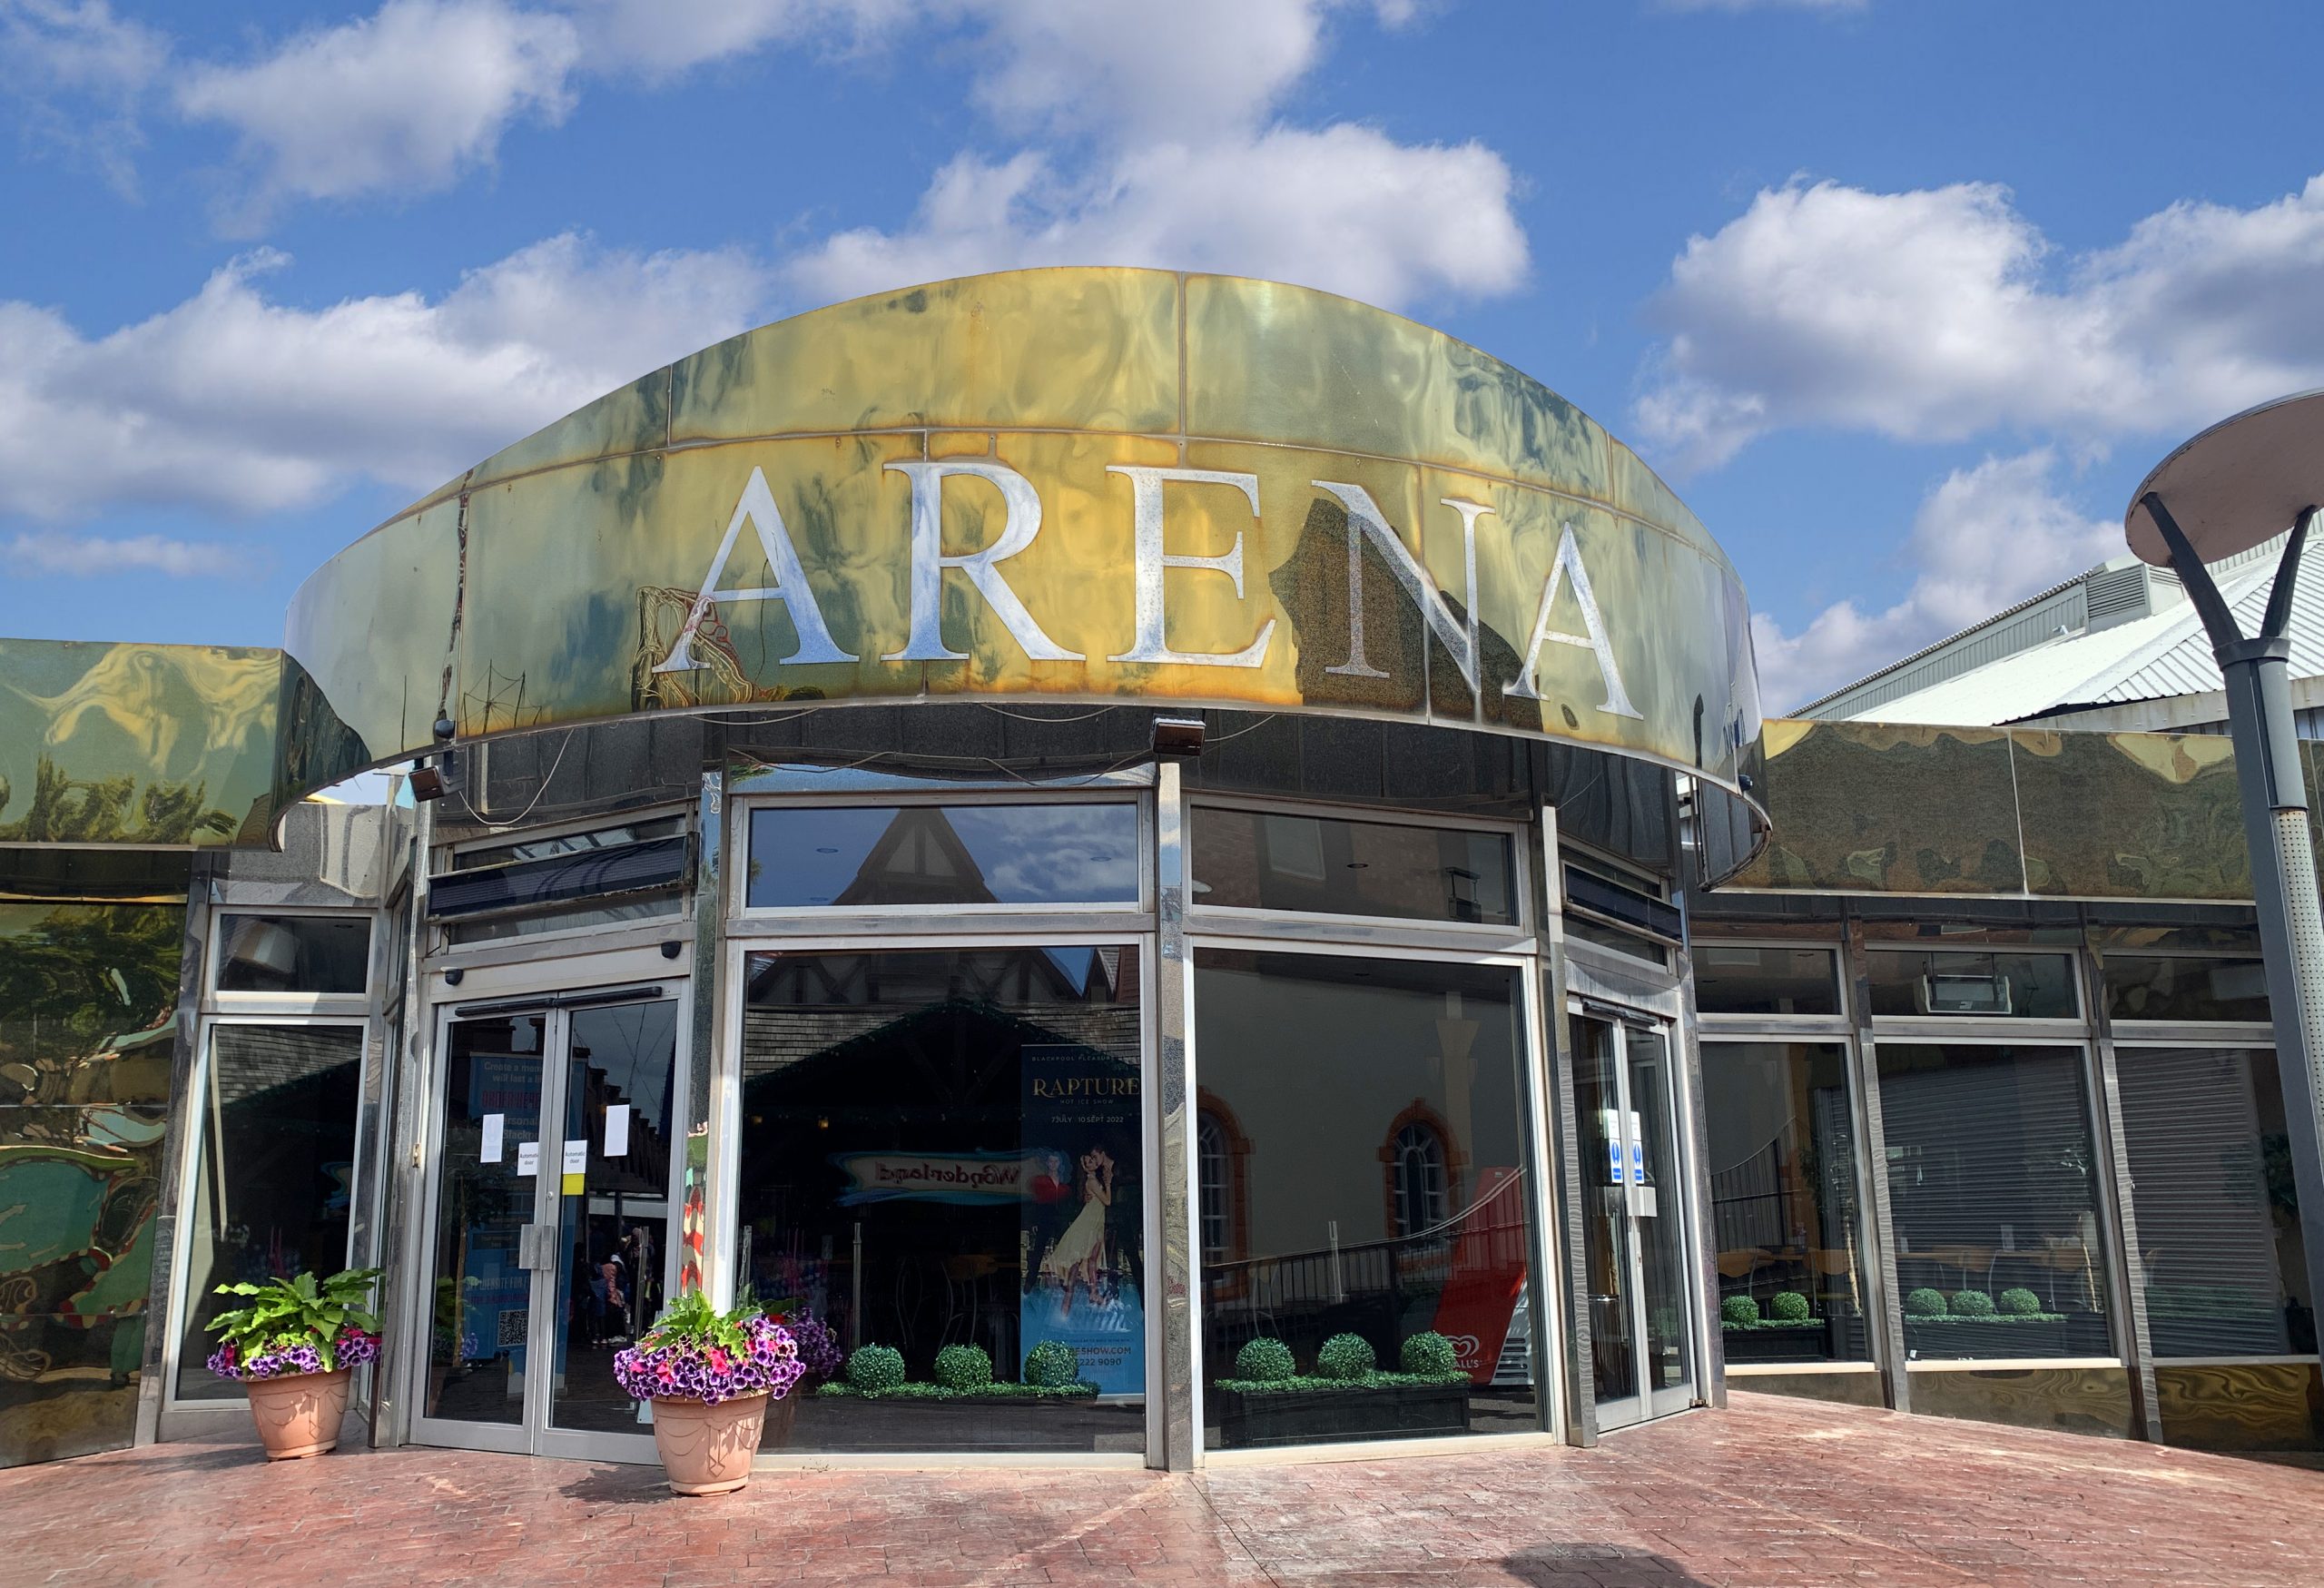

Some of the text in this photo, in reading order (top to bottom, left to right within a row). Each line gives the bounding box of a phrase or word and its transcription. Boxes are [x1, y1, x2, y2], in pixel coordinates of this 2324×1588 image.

[652, 462, 1644, 720] ARENA
[1032, 1077, 1140, 1099] RAPTURE
[1079, 1358, 1122, 1366] 222 9090
[1453, 1359, 1481, 1369] ALL'S
